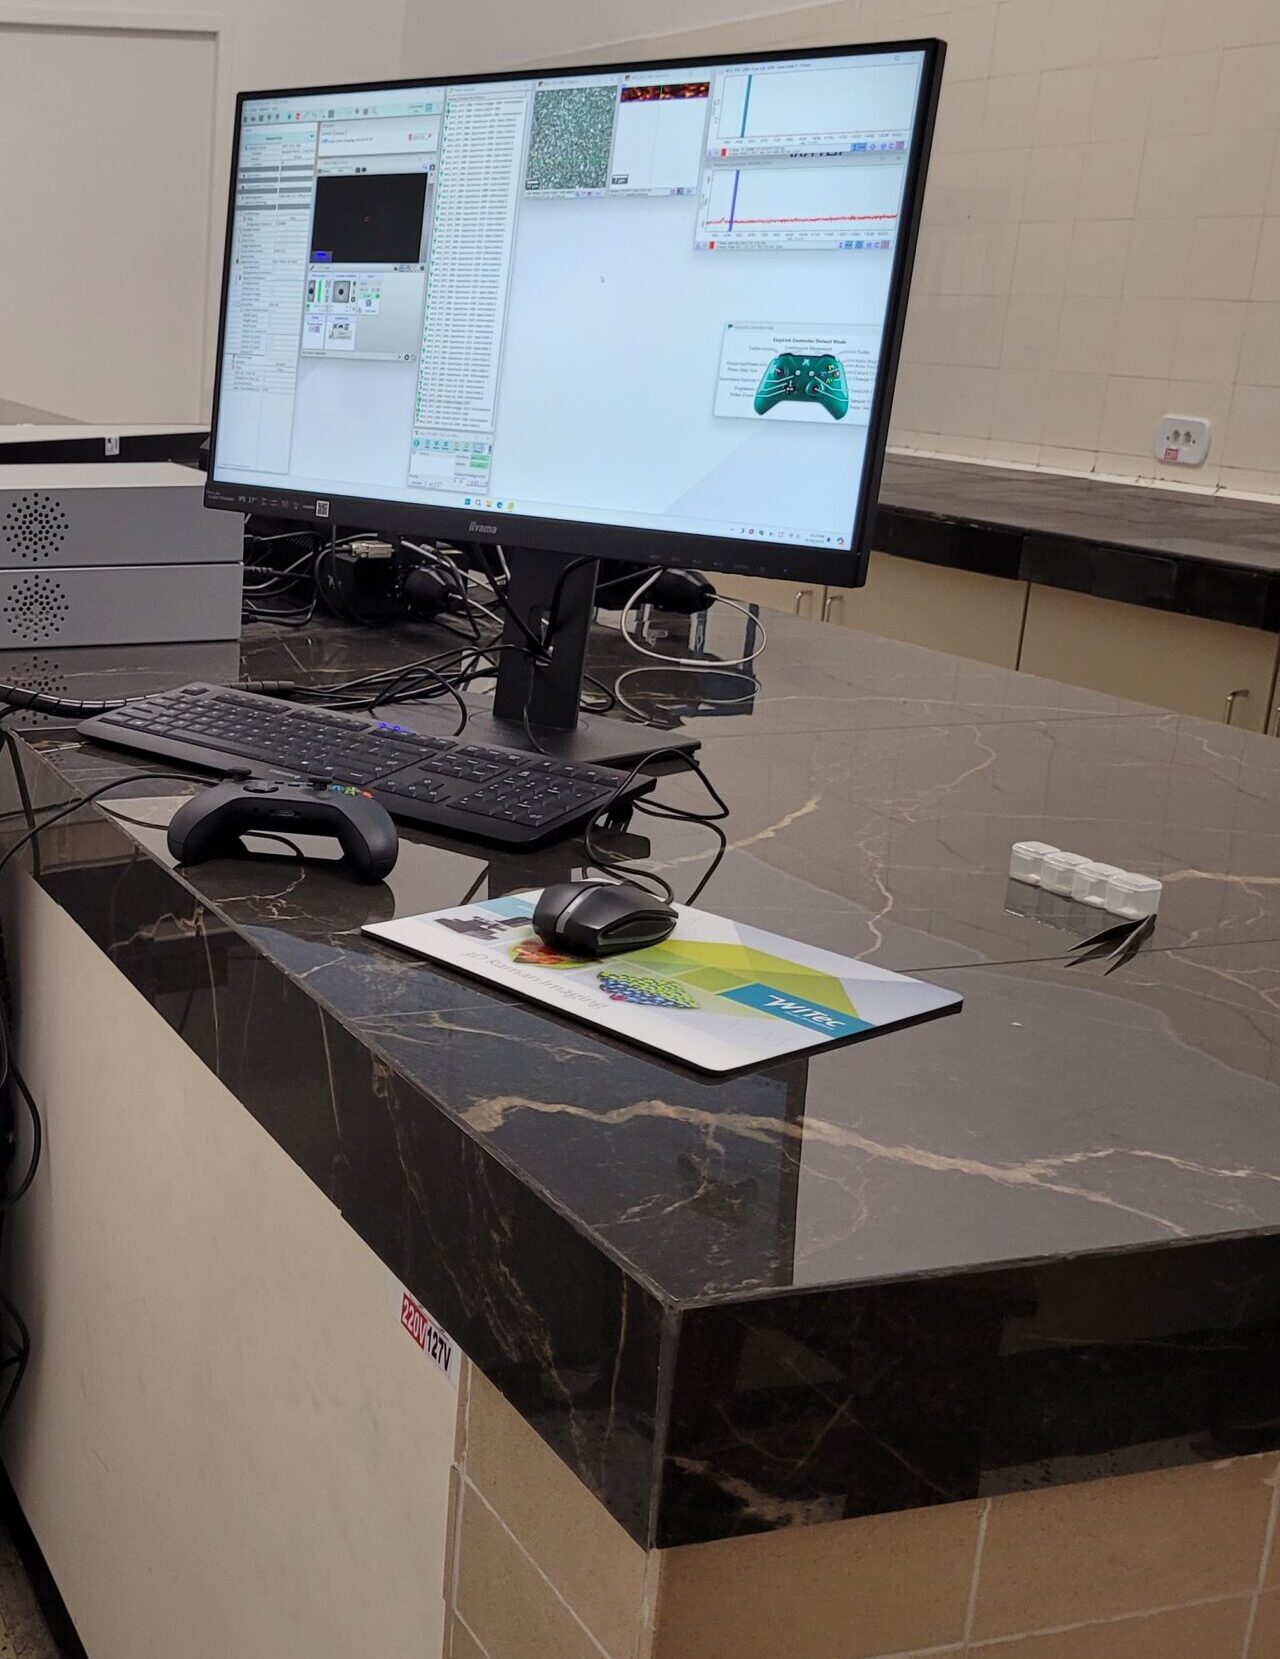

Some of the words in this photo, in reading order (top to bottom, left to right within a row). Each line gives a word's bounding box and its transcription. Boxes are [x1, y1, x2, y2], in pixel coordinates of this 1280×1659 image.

[489, 959, 544, 985] Raman
[539, 979, 609, 1010] Imaging
[763, 994, 846, 1027] WITec
[402, 1299, 427, 1344] 220V
[427, 1326, 451, 1372] 127V
